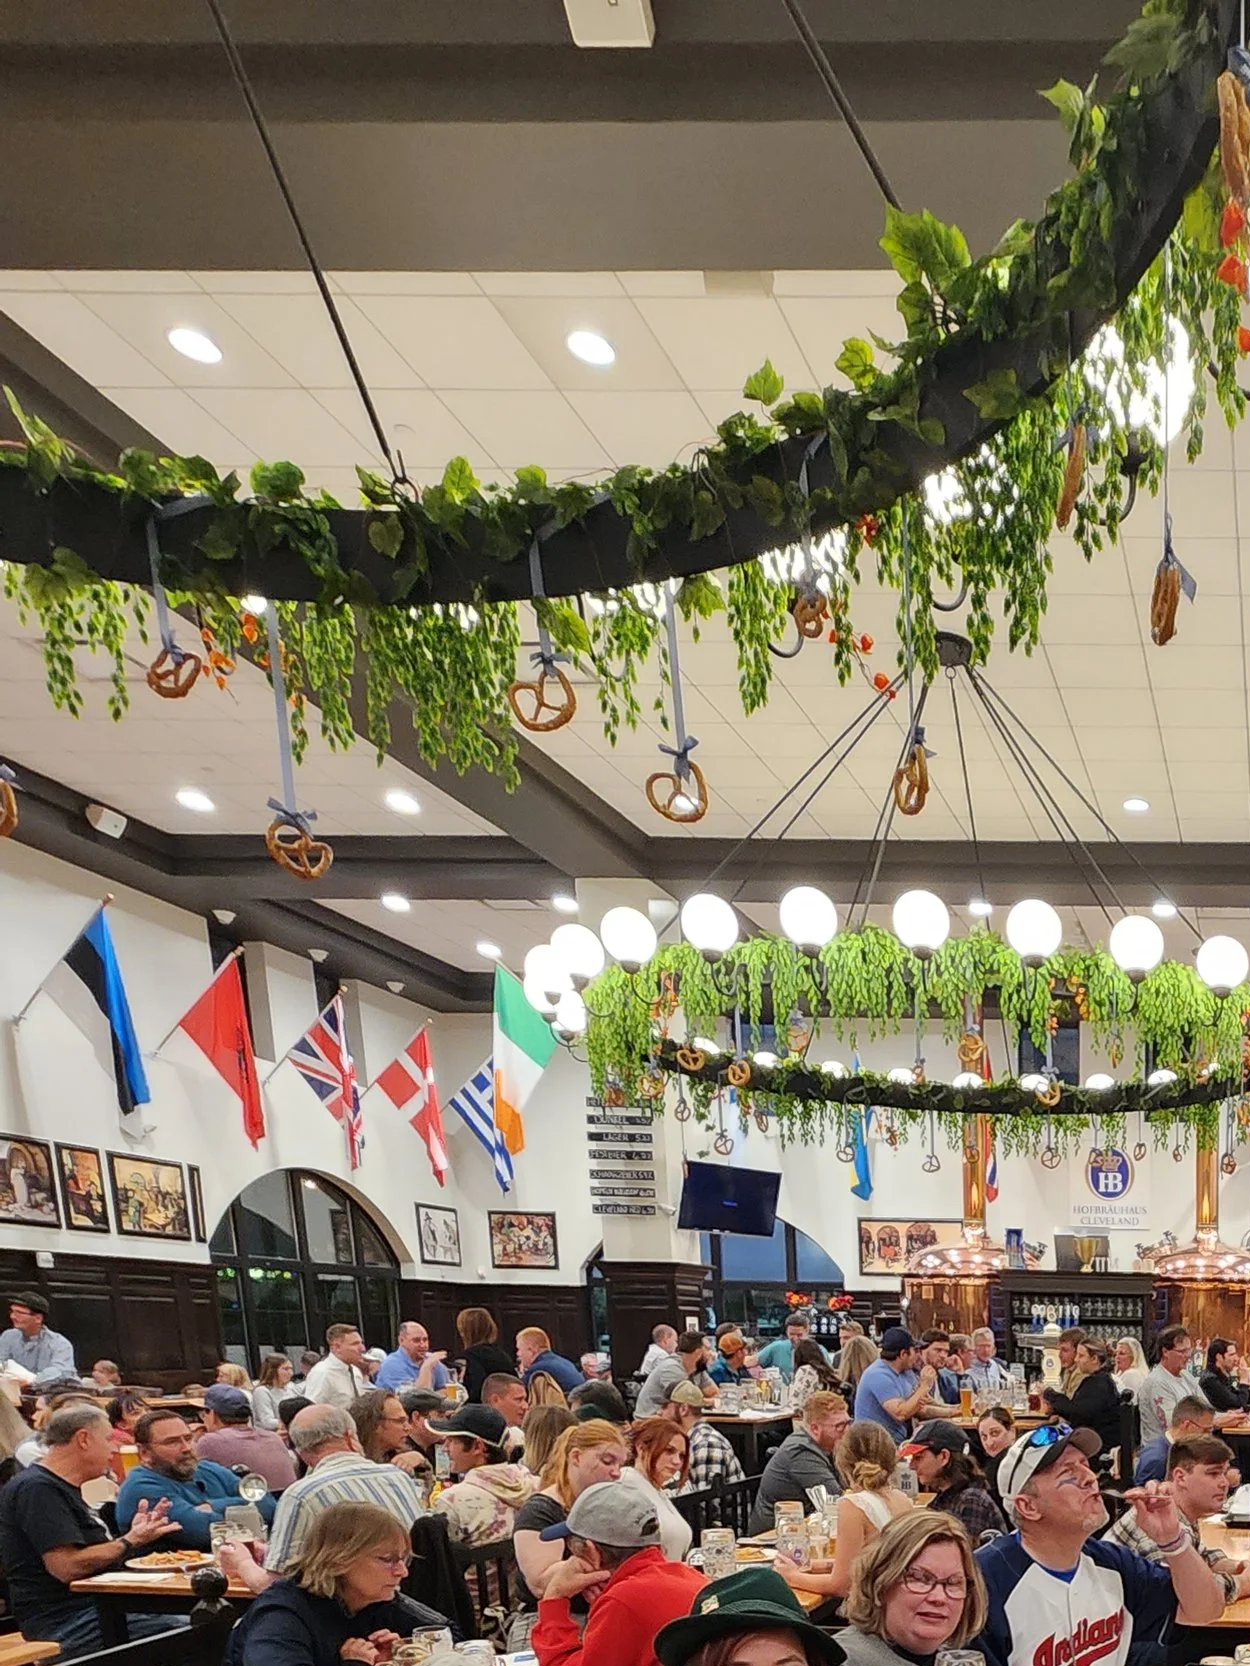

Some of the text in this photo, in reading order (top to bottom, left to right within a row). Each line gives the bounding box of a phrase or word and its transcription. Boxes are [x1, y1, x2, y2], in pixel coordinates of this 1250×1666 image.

[1098, 1172, 1123, 1193] HB
[1072, 1204, 1148, 1215] HOFBRÄUHAUS
[1080, 1216, 1140, 1226] CLEVELAND
